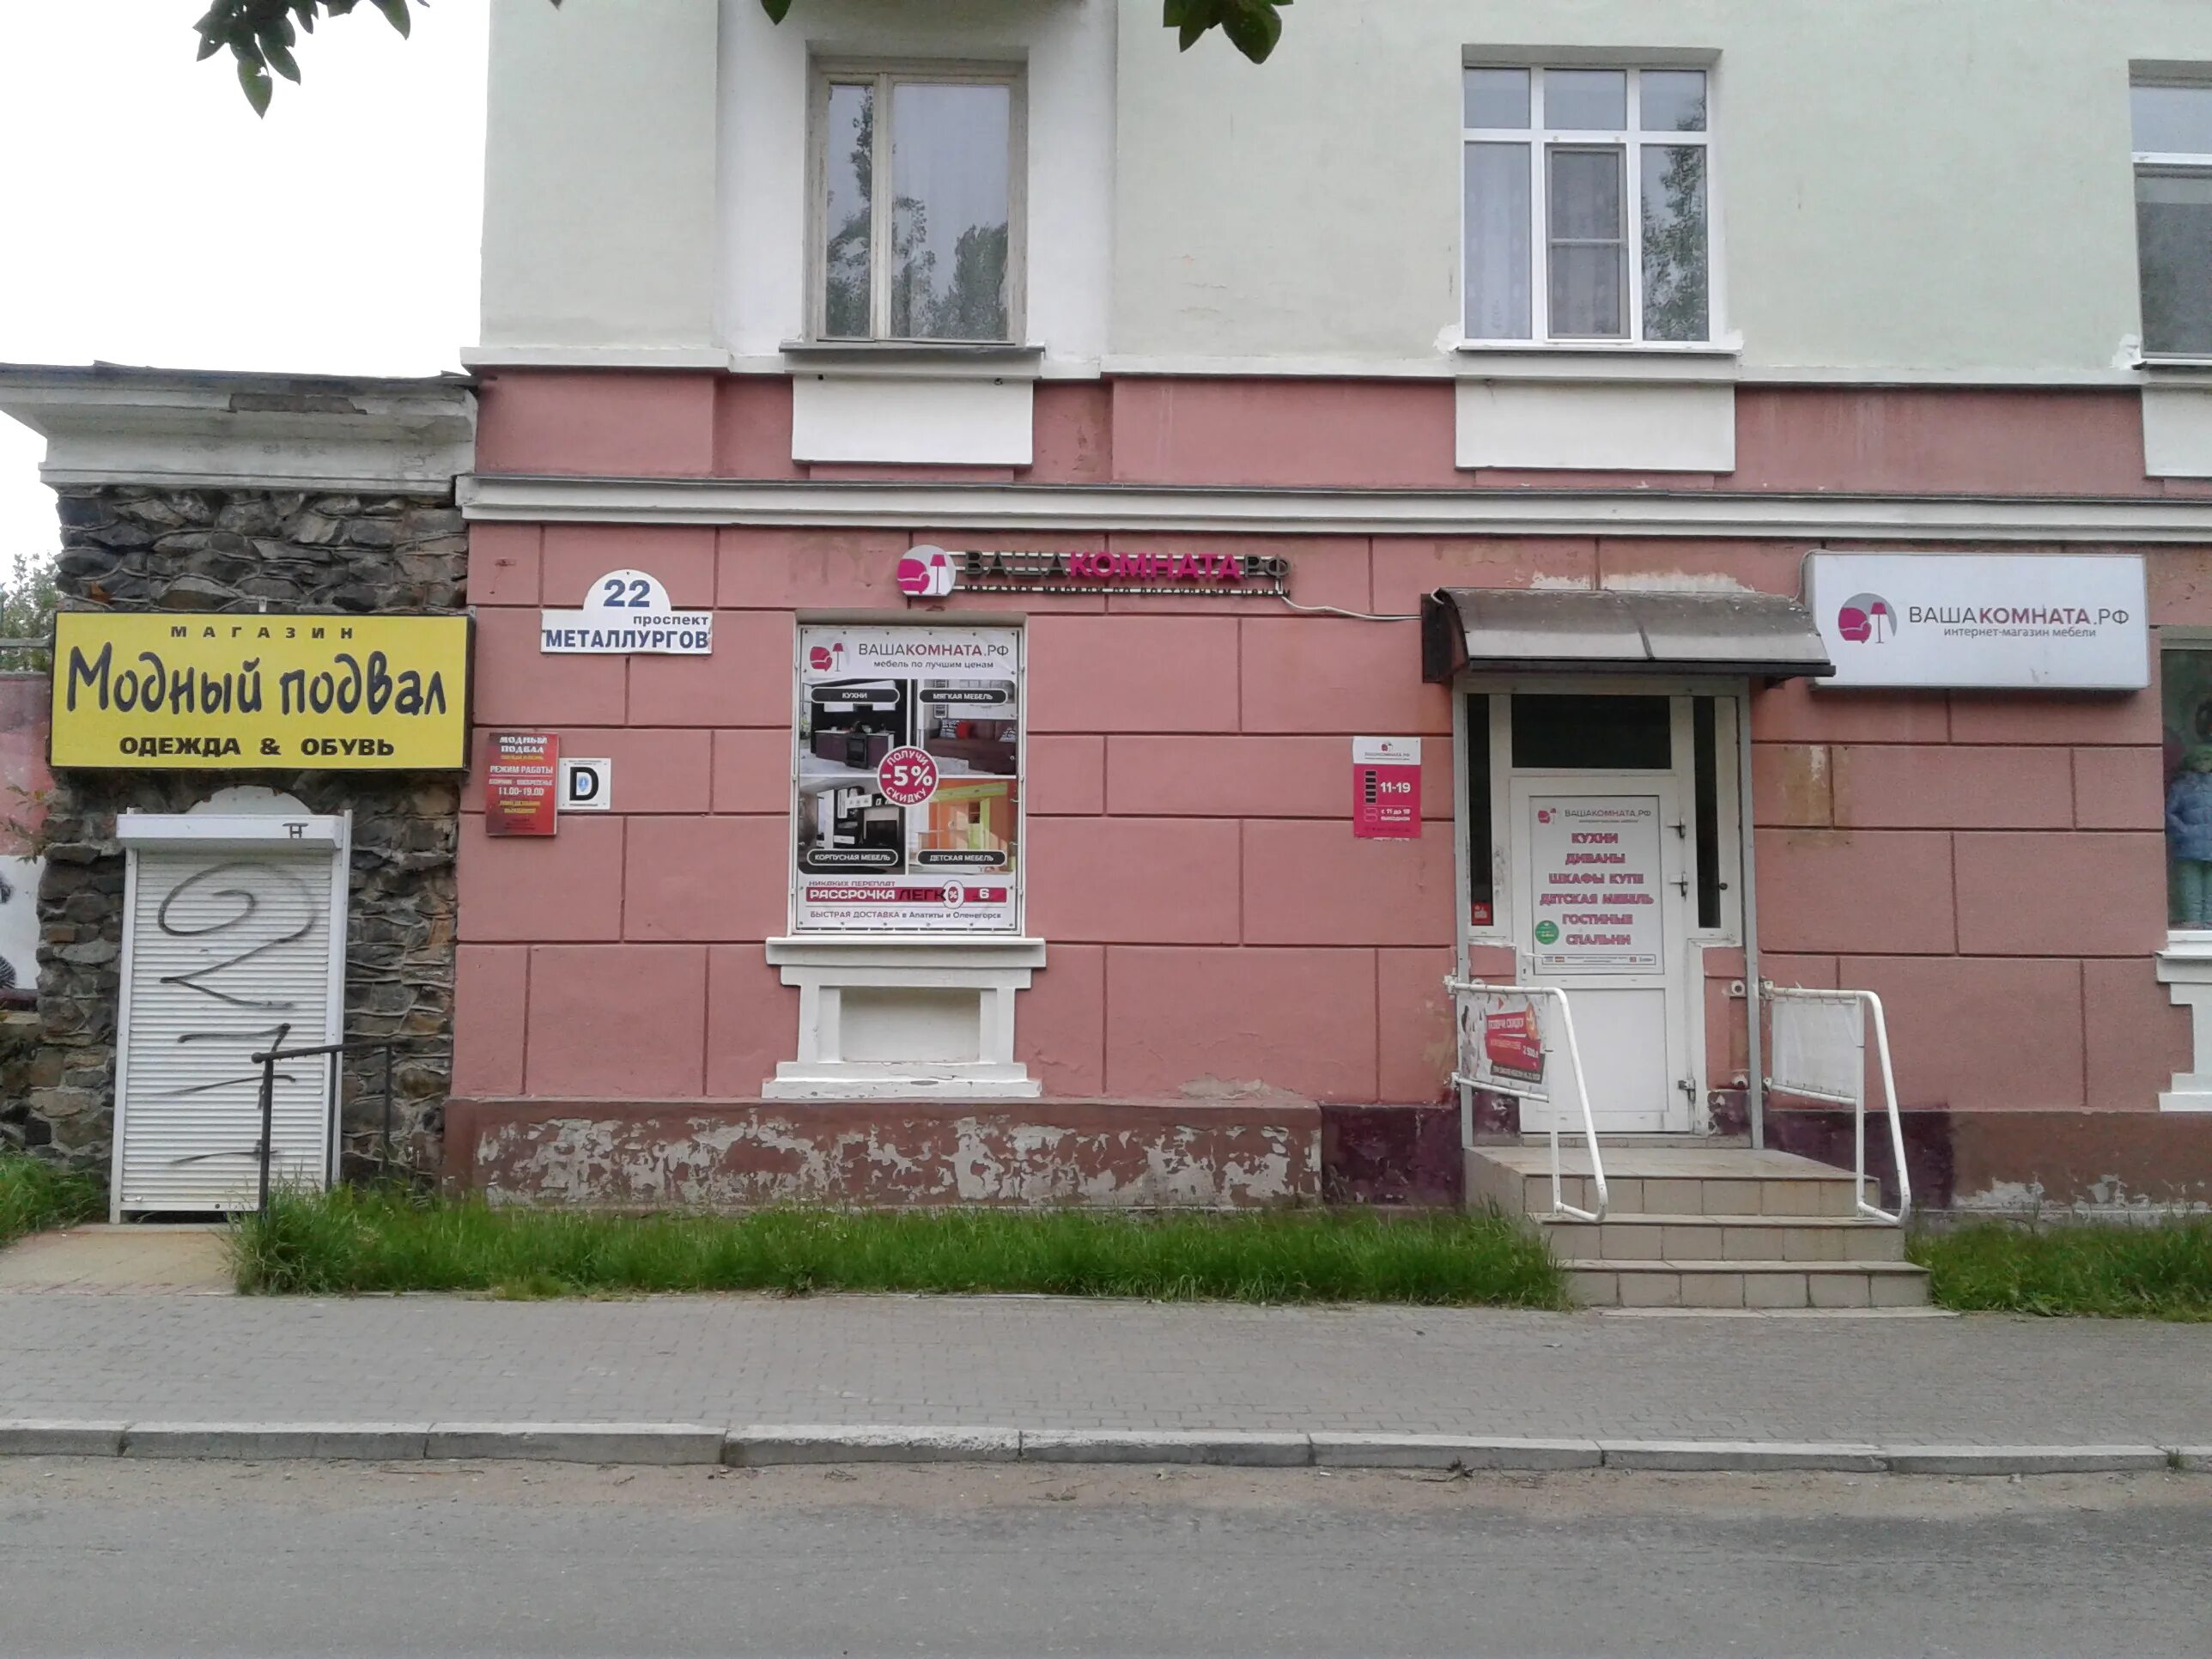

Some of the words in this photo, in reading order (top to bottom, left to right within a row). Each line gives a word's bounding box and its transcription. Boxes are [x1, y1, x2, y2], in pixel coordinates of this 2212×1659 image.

[604, 579, 650, 607] 22
[633, 616, 708, 626] проспект
[1909, 605, 2129, 626] ВАШАКОМНАТА.РФ
[171, 625, 355, 640] МАГАЗИН
[545, 629, 708, 648] МЕТАЛЛУРГОВ
[1943, 628, 2049, 639] интернет-магазин
[2052, 627, 2096, 638] мебели
[859, 643, 1009, 656] ВАШАКОМНАТА.РФ
[926, 661, 962, 670] лучшим
[68, 642, 262, 715] Модный
[280, 651, 446, 716] подвал
[118, 737, 240, 758] ОДЕЖДА
[259, 737, 281, 756] &
[301, 738, 394, 757] ОБУВЬ
[501, 745, 544, 754] ПОДВАЛ
[887, 750, 928, 766] ПОЛУЧИ
[489, 765, 520, 774] РЕЖИМ
[882, 765, 933, 786] -5%
[1380, 781, 1411, 793] 11-19
[886, 787, 927, 803] СКИДКУ
[1571, 833, 1618, 843] КУХНИ
[1565, 853, 1626, 866] ДИВАНЫ
[1548, 872, 1605, 884] ШКАФЫ
[1609, 873, 1644, 884] КУПЕ
[810, 889, 896, 900] РАССРОЧКА
[1540, 893, 1598, 906] ДЕТСКАЯ
[1562, 914, 1633, 925] ГОСТИНЫЕ
[1565, 933, 1632, 945] СПАЛЬНИ
